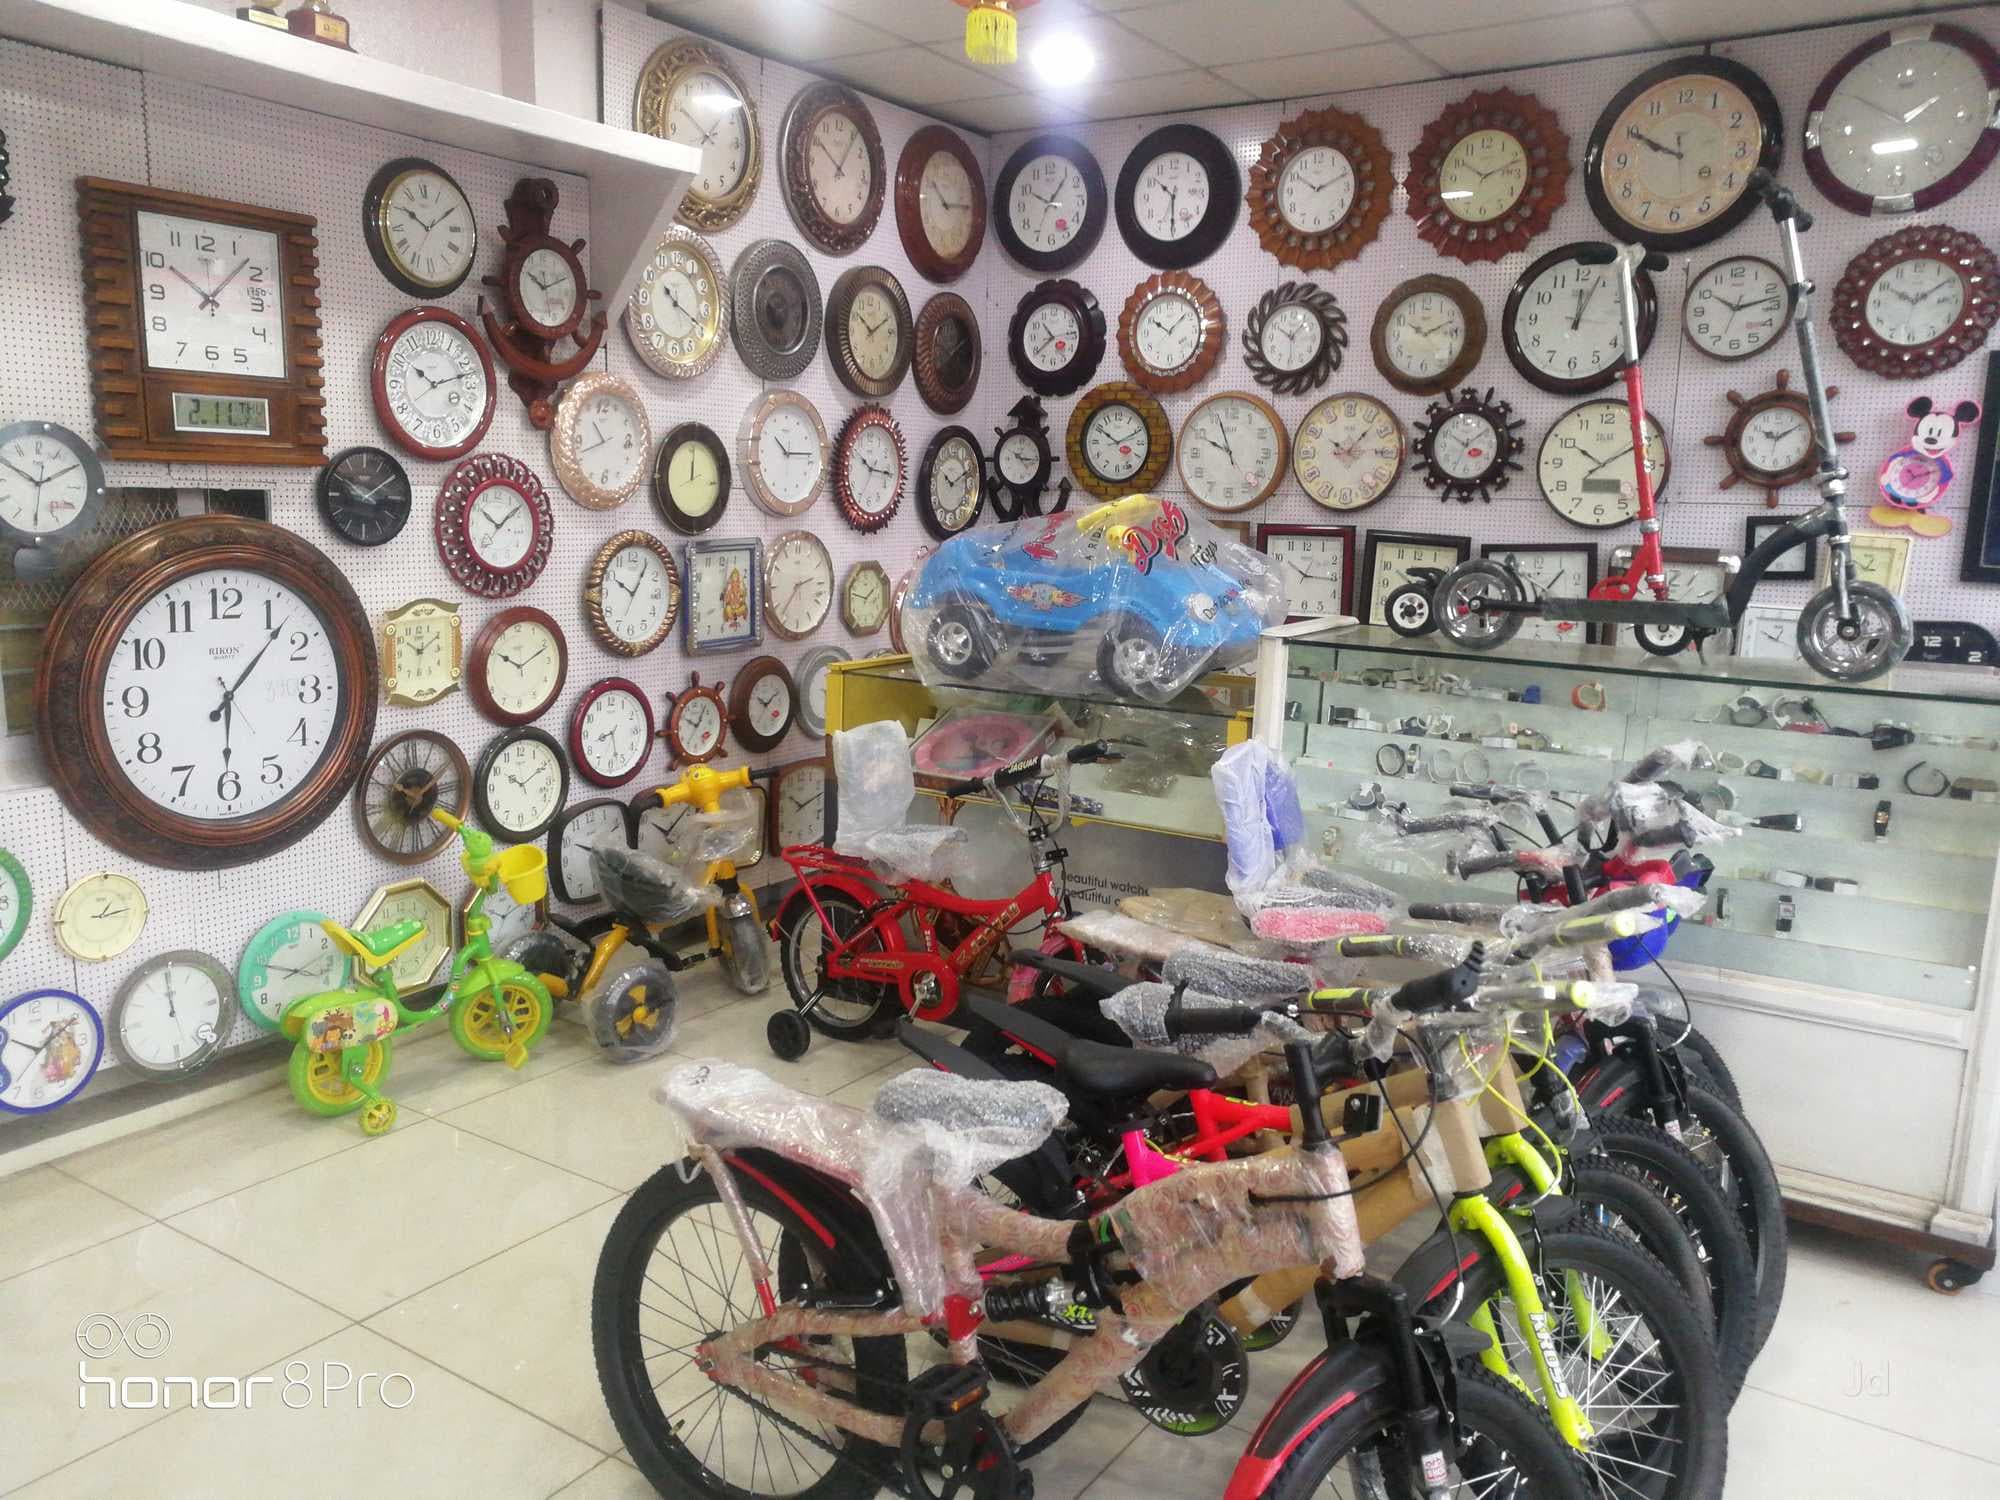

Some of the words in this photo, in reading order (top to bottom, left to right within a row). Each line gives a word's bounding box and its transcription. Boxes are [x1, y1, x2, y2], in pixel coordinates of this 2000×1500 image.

[1679, 89, 1694, 104] 12
[1711, 92, 1718, 108] 1
[1650, 102, 1661, 116] 11
[1730, 113, 1742, 128] 2
[671, 123, 676, 134] 9
[1627, 125, 1639, 139] 10
[1482, 136, 1493, 148] 12
[1466, 144, 1473, 156] 11
[1735, 142, 1746, 158] 3
[1313, 152, 1323, 164] 12
[1617, 155, 1628, 169] 9
[1045, 162, 1055, 175] 12
[1170, 160, 1179, 169] 12
[1300, 160, 1307, 170] 11
[1033, 169, 1040, 180] 11
[1724, 173, 1734, 188] 4
[704, 179, 709, 190] 6
[1072, 176, 1080, 188] 2
[1022, 185, 1031, 195] 10
[1287, 187, 1293, 197] 9
[1622, 181, 1632, 197] 8
[1018, 201, 1025, 212] 9
[1290, 203, 1295, 213] 8
[1641, 201, 1651, 218] 7
[1698, 196, 1711, 213] 5
[1072, 211, 1079, 224] 4
[1329, 210, 1335, 220] 5
[1669, 206, 1681, 222] 6
[1022, 218, 1030, 229] 8
[1314, 216, 1320, 225] 6
[171, 231, 180, 247] 11
[1034, 230, 1040, 242] 7
[1048, 234, 1055, 245] 6
[195, 235, 215, 252] 12
[232, 241, 236, 256] 1
[146, 252, 164, 268] 10
[659, 255, 665, 267] 11
[674, 253, 684, 265] 12
[249, 267, 263, 282] 2
[647, 269, 654, 281] 10
[1576, 268, 1591, 281] 12
[1731, 267, 1745, 278] 12
[1554, 275, 1565, 288] 11
[1715, 273, 1723, 285] 11
[150, 284, 166, 300] 9
[700, 281, 706, 291] 2
[1765, 283, 1777, 294] 2
[641, 291, 647, 303] 9
[1537, 292, 1552, 304] 10
[1699, 289, 1712, 299] 10
[251, 298, 264, 313] 3
[703, 304, 709, 316] 3
[1694, 307, 1704, 317] 9
[152, 317, 167, 332] 8
[645, 317, 652, 328] 8
[1529, 314, 1537, 325] 9
[252, 326, 266, 342] 4
[1698, 324, 1709, 333] 8
[407, 336, 418, 352] 11
[656, 334, 661, 346] 7
[1532, 336, 1540, 347] 8
[1609, 336, 1617, 348] 4
[1711, 336, 1721, 346] 7
[1748, 333, 1759, 343] 5
[176, 342, 189, 356] 7
[672, 343, 678, 354] 6
[687, 340, 693, 351] 5
[1729, 340, 1740, 349] 6
[205, 346, 219, 360] 6
[234, 348, 248, 363] 5
[1547, 351, 1556, 363] 7
[1592, 351, 1600, 363] 5
[393, 353, 405, 368] 10
[459, 357, 469, 368] 2
[1568, 357, 1576, 369] 6
[390, 380, 401, 389] 9
[397, 403, 408, 414] 8
[597, 399, 609, 413] 12
[413, 418, 422, 431] 7
[1600, 413, 1615, 424] 12
[433, 424, 440, 438] 6
[452, 419, 459, 432] 5
[1580, 420, 1589, 430] 11
[1560, 438, 1576, 448] 10
[1552, 458, 1563, 468] 9
[601, 470, 608, 484] 6
[1556, 481, 1567, 491] 8
[1572, 497, 1582, 508] 7
[1618, 499, 1628, 509] 5
[1593, 505, 1604, 515] 6
[1288, 541, 1294, 551] 11
[1304, 542, 1311, 551] 12
[628, 552, 638, 562] 12
[1191, 539, 1218, 569] Toys
[1398, 549, 1404, 559] 11
[1414, 551, 1423, 560] 12
[616, 556, 622, 567] 11
[1331, 556, 1337, 565] 2
[1384, 561, 1391, 570] 10
[1383, 578, 1389, 588] 9
[1331, 589, 1336, 599] 4
[208, 588, 243, 620] 12
[1301, 600, 1308, 610] 6
[1317, 601, 1323, 611] 5
[167, 600, 194, 632] 11
[264, 600, 272, 630] 1
[606, 607, 612, 616] 8
[627, 625, 633, 635] 6
[640, 620, 647, 631] 5
[290, 632, 308, 661] 2
[1923, 636, 1942, 647] 12
[1954, 637, 1960, 647] 1
[132, 638, 165, 671] 10
[209, 647, 240, 655] RIKON
[1968, 652, 1981, 663] 2
[299, 676, 321, 703] 3
[122, 686, 149, 718] 9
[608, 696, 615, 706] 12
[287, 718, 307, 746] 4
[137, 733, 162, 764] 8
[517, 747, 525, 756] 12
[261, 755, 283, 784] 5
[493, 767, 500, 776] 10
[171, 765, 195, 797] 7
[217, 771, 241, 801] 6
[321, 938, 328, 950] 2
[261, 993, 267, 1004] 8
[29, 1001, 40, 1013] 12
[275, 1003, 281, 1014] 7
[80, 1034, 87, 1045] 3
[14, 1087, 21, 1099] 7
[1529, 1311, 1570, 1399] KROSS
